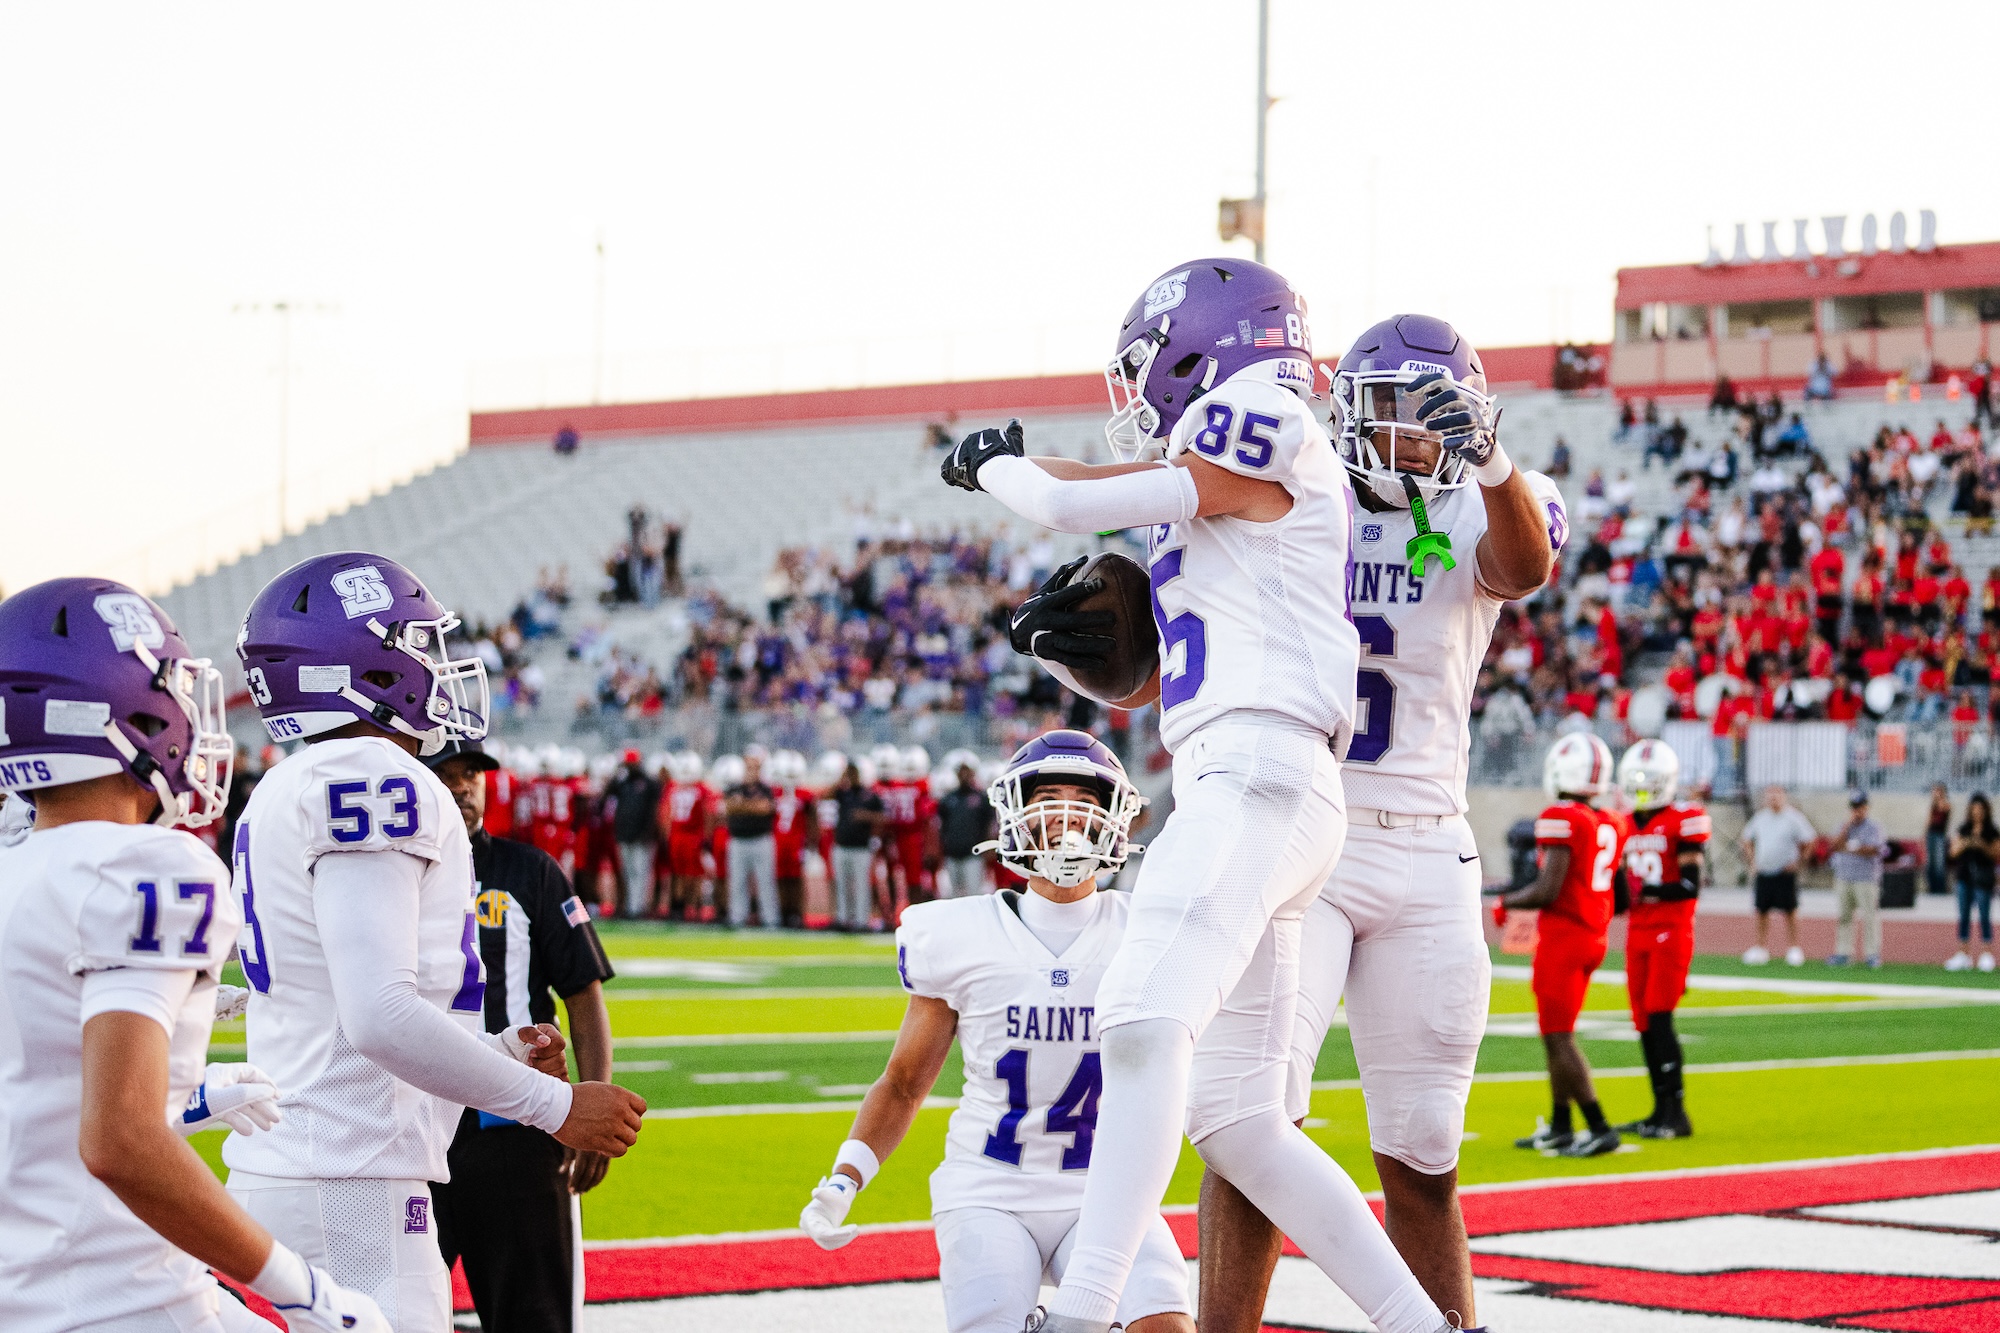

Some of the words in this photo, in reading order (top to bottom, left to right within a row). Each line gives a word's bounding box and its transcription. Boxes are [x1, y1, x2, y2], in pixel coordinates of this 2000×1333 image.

[1195, 400, 1283, 472] 85
[1413, 500, 1428, 532] BATTLE
[325, 773, 422, 846] 53
[1591, 824, 1618, 892] 2
[127, 877, 217, 957] 17
[475, 889, 511, 928] CIF
[1006, 1005, 1101, 1041] SAINT
[982, 1047, 1101, 1172] 14
